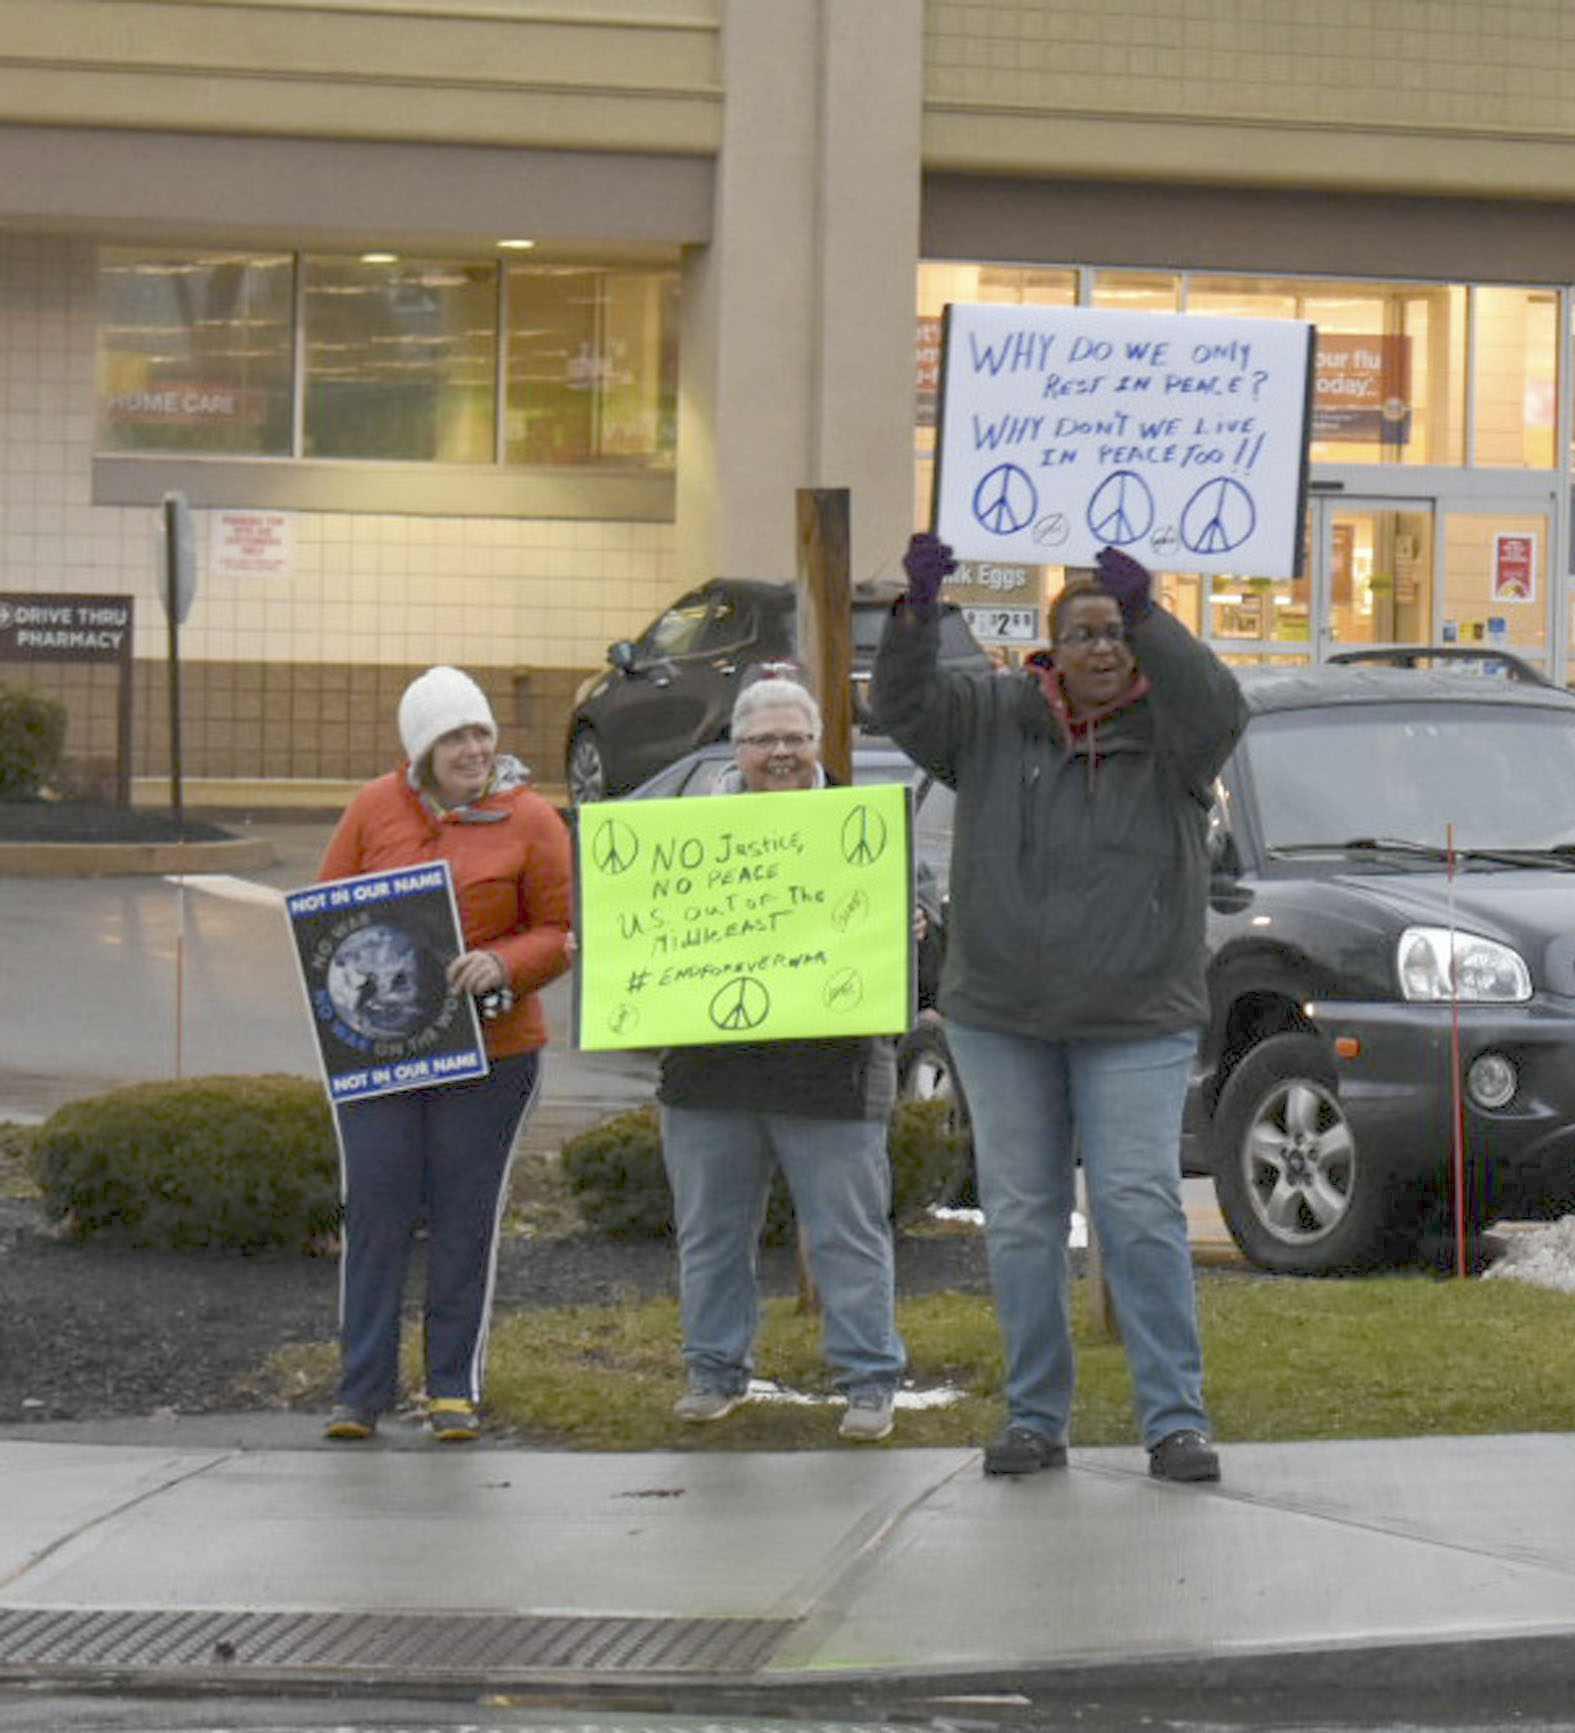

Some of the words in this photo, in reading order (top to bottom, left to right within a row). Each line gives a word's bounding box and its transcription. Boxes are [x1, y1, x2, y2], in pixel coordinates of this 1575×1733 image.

[968, 330, 1055, 377] WHY
[1068, 336, 1112, 363] DO
[1125, 341, 1170, 367] WE
[1316, 352, 1349, 368] our
[1353, 347, 1381, 369] flu
[1043, 372, 1106, 399] REST
[1114, 375, 1152, 393] IN
[971, 413, 1044, 452] WHY
[1140, 417, 1183, 439] WE
[1041, 447, 1078, 466] IN
[1099, 443, 1177, 465] PEACE
[979, 564, 1028, 591] Eggs
[15, 607, 73, 625] DRIVE
[78, 606, 127, 627] THRU
[17, 631, 125, 650] PHARMACY
[651, 836, 705, 874] NO
[290, 893, 327, 914] NOT
[330, 887, 350, 907] IN
[353, 879, 391, 902] OUR
[393, 870, 444, 893] NAME
[652, 876, 693, 900] NO
[707, 862, 780, 890] PEACE
[333, 1071, 369, 1093] NOT
[372, 1066, 391, 1085] IN
[394, 1059, 430, 1080] OUR
[433, 1051, 478, 1074] NAME
